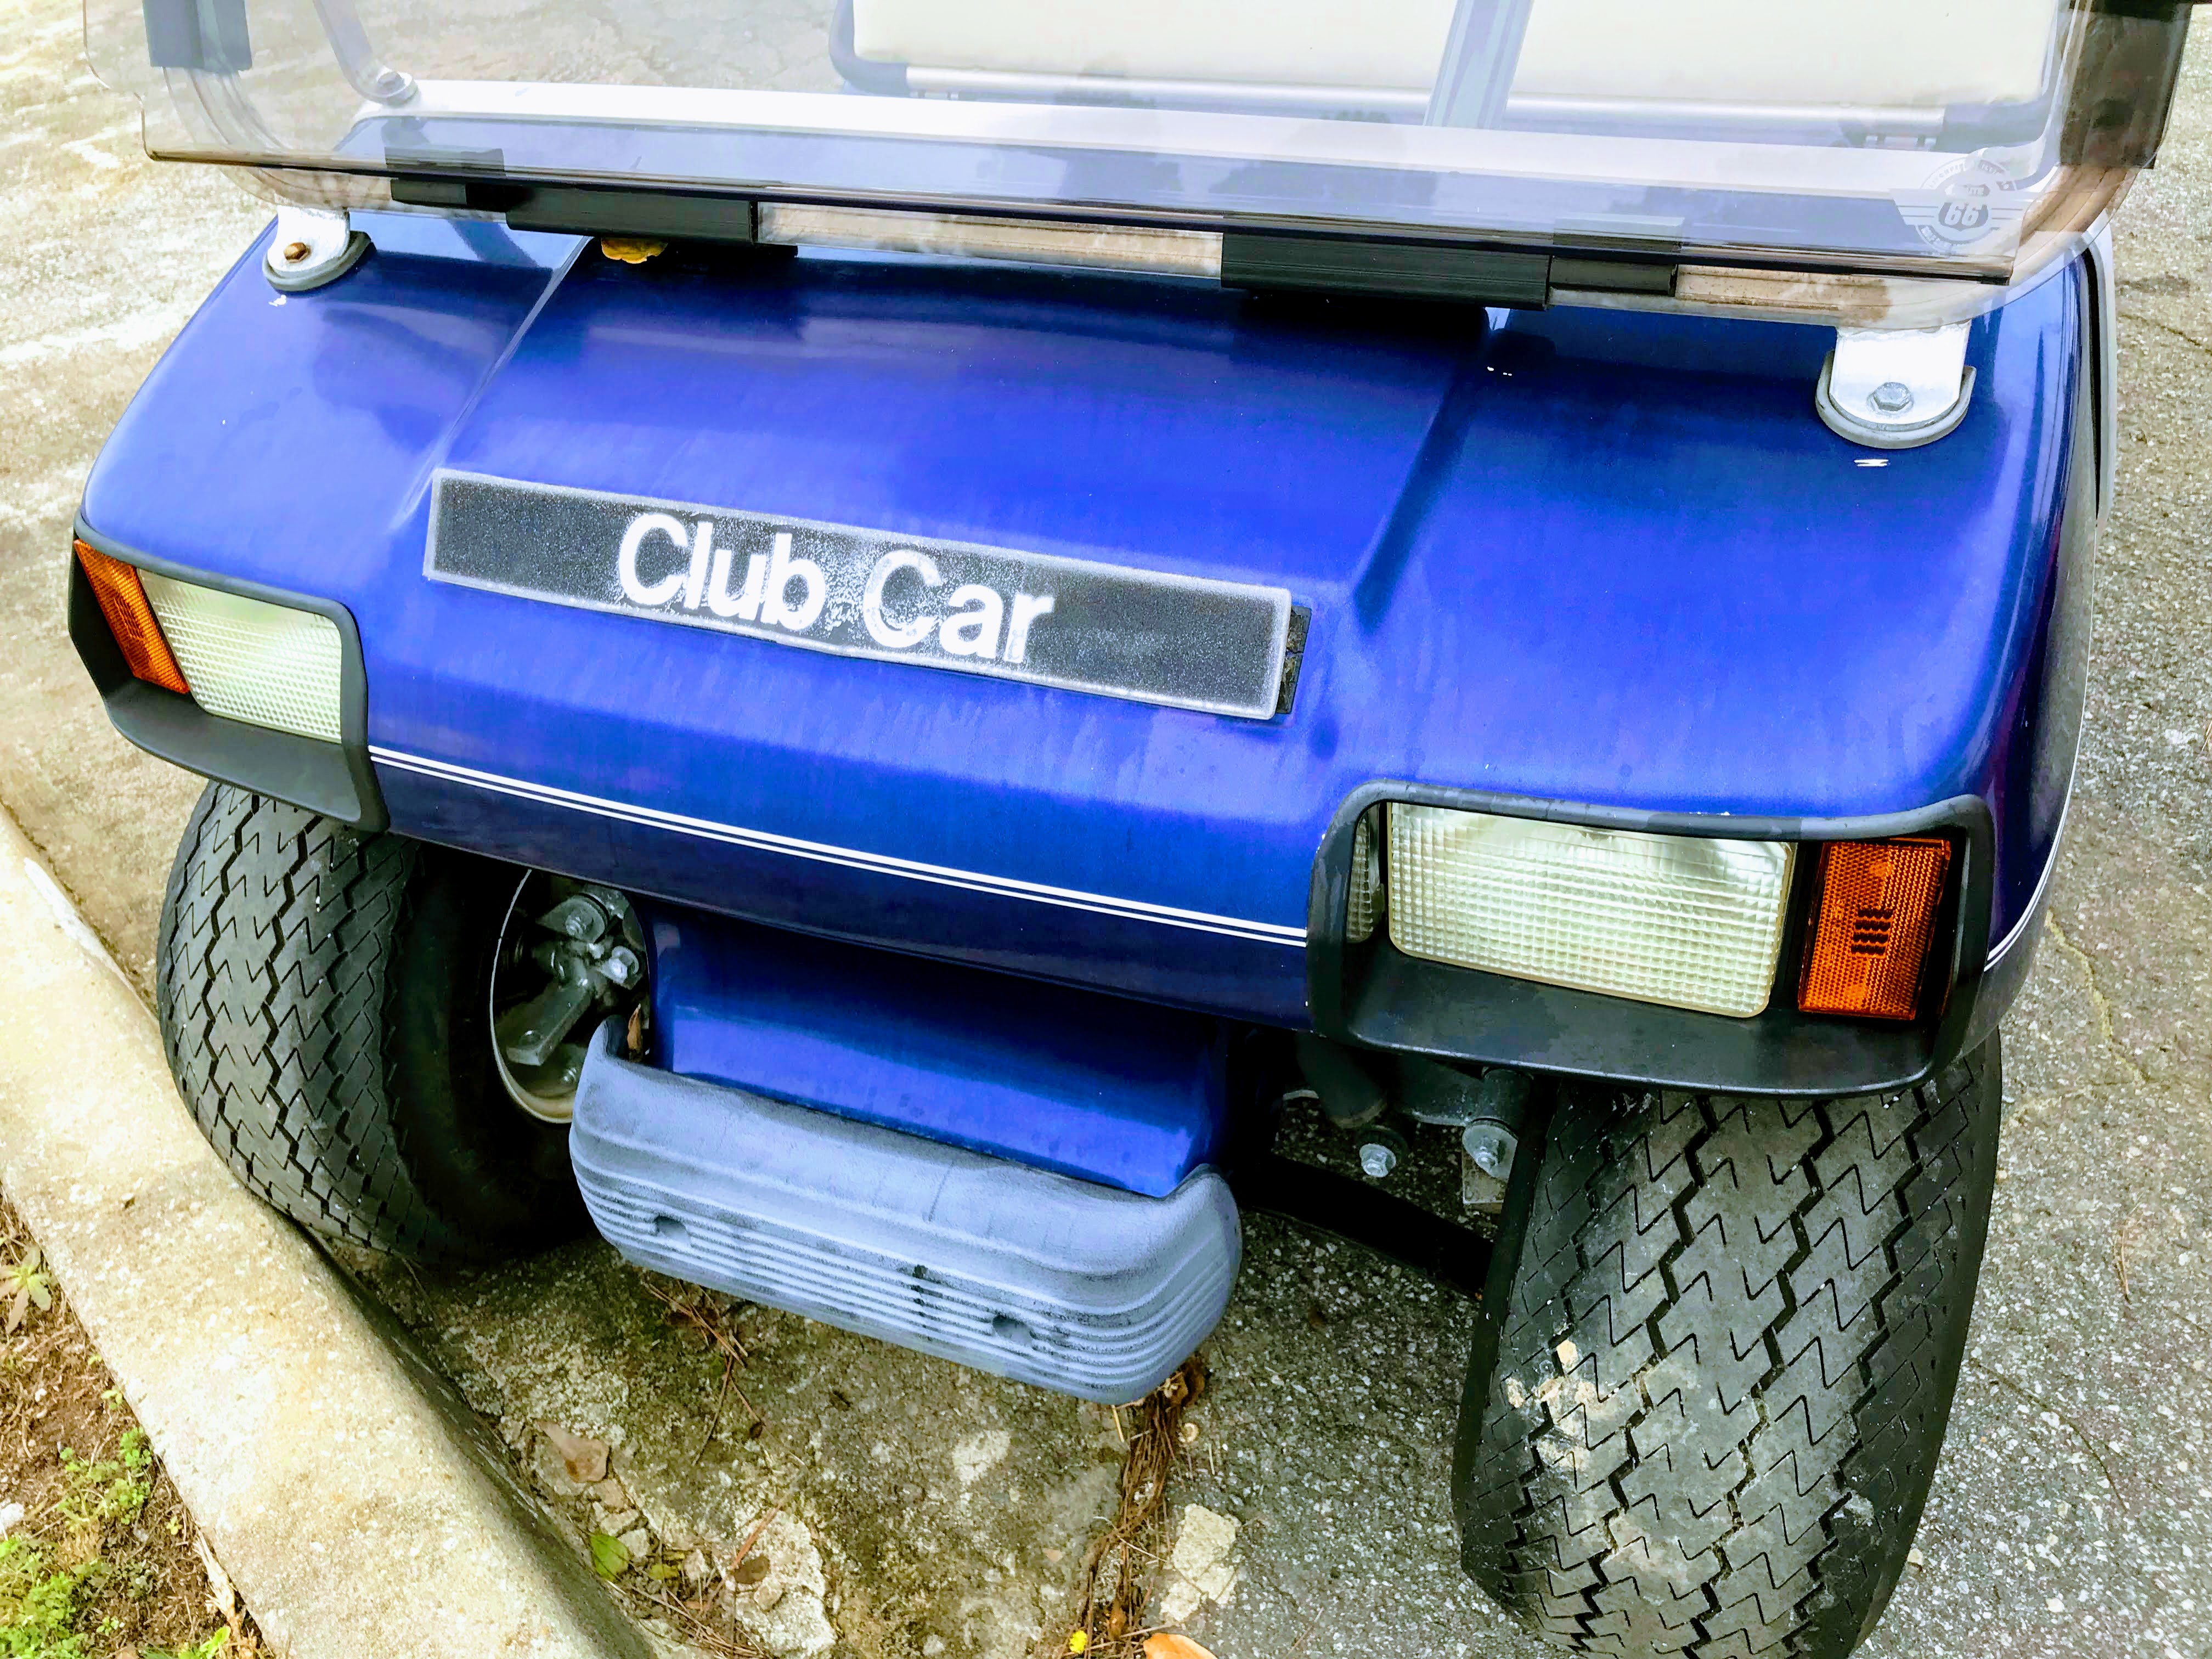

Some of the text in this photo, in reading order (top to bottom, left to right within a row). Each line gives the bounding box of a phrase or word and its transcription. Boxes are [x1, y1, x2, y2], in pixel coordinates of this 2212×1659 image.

[1944, 201, 1982, 227] 66
[618, 513, 1054, 663] Club Car
